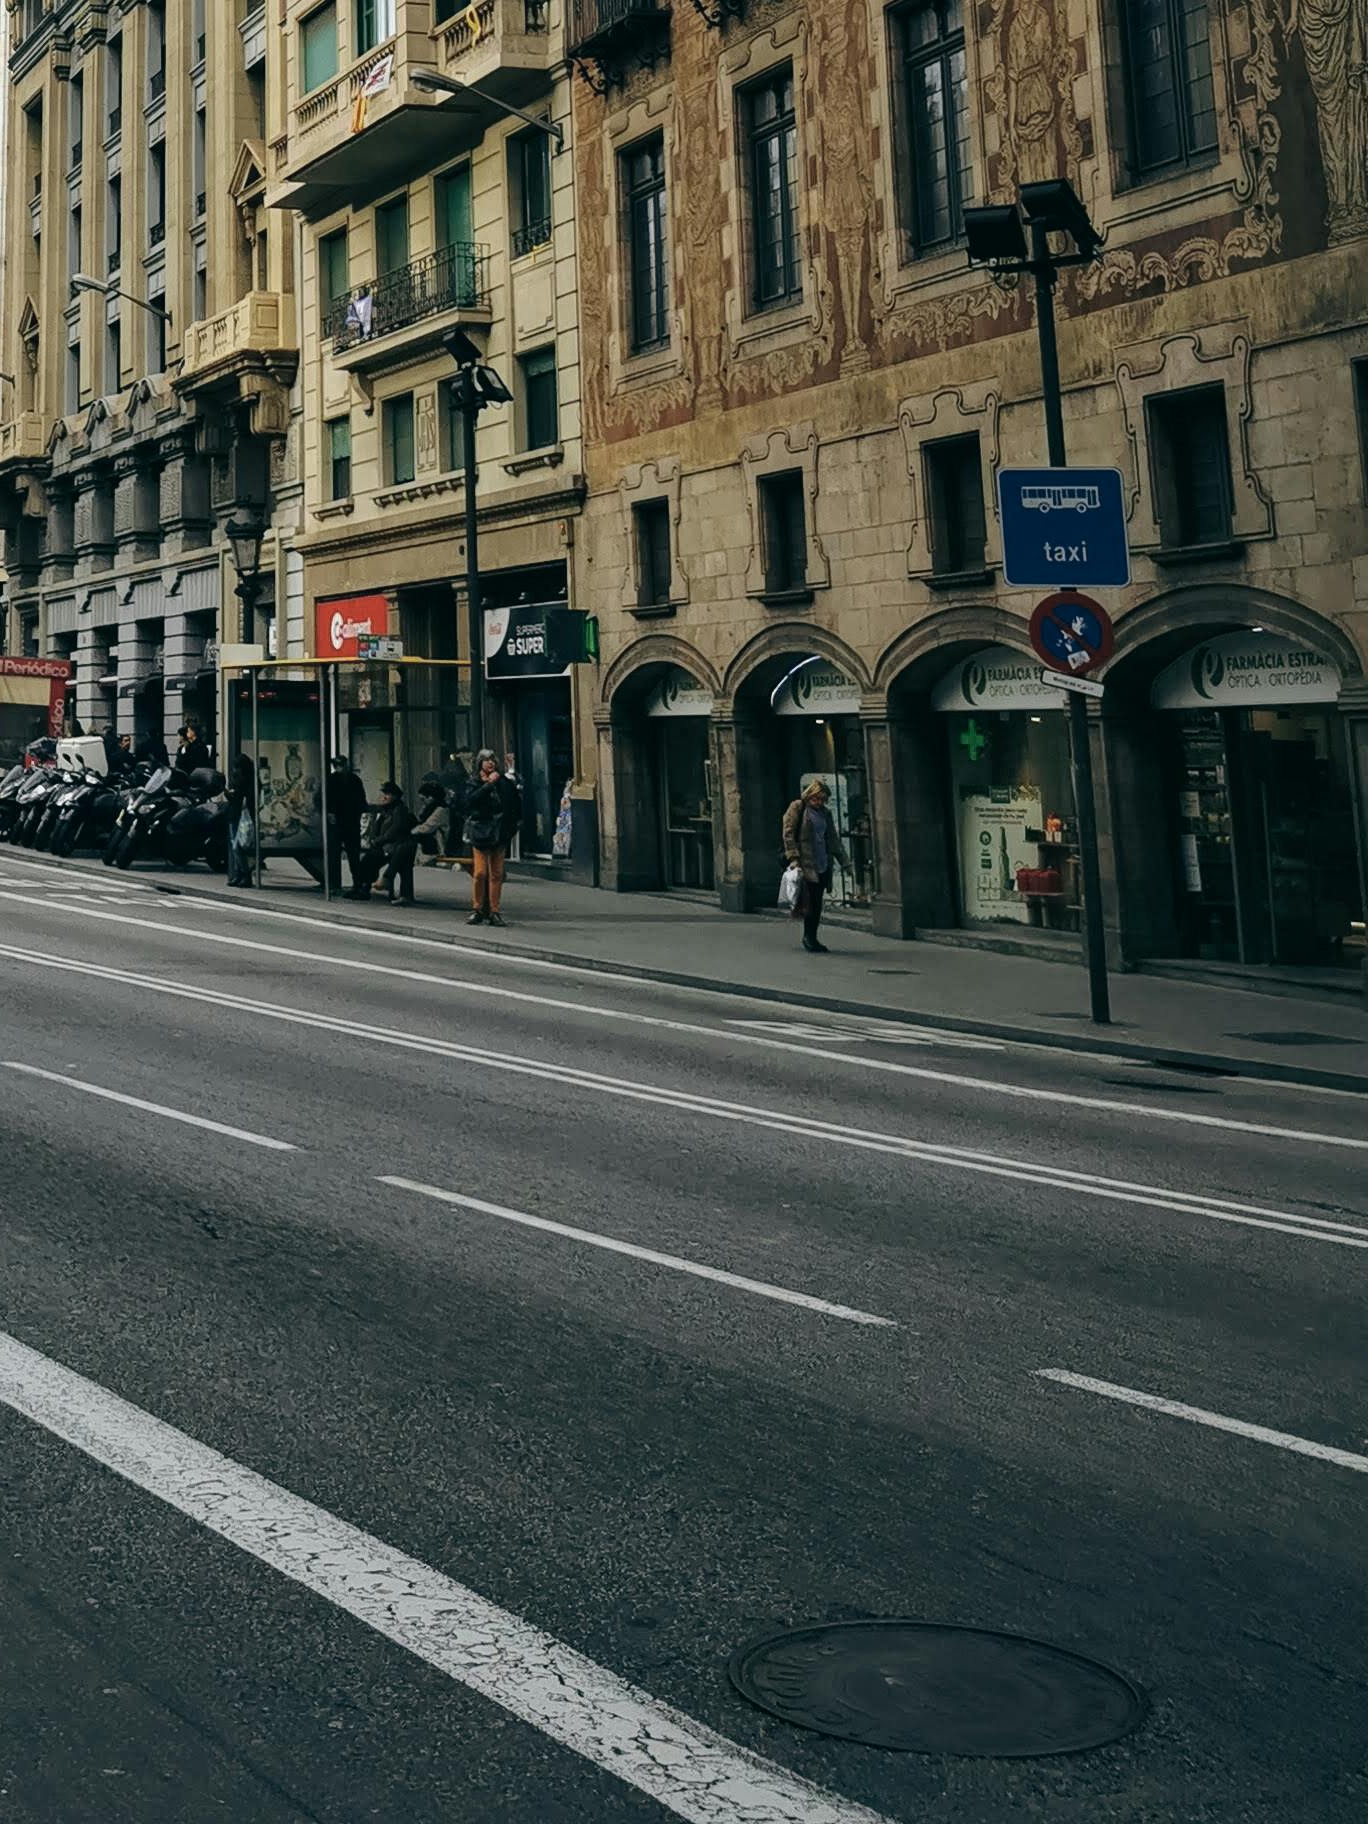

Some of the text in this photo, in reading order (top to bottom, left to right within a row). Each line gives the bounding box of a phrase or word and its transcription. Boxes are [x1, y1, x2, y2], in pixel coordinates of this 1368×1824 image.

[1043, 540, 1088, 563] taxi
[516, 622, 546, 637] SUPERMERC
[516, 636, 545, 656] SUPER
[5, 660, 69, 677] Periódico
[1226, 650, 1286, 672] FARMÀCIA
